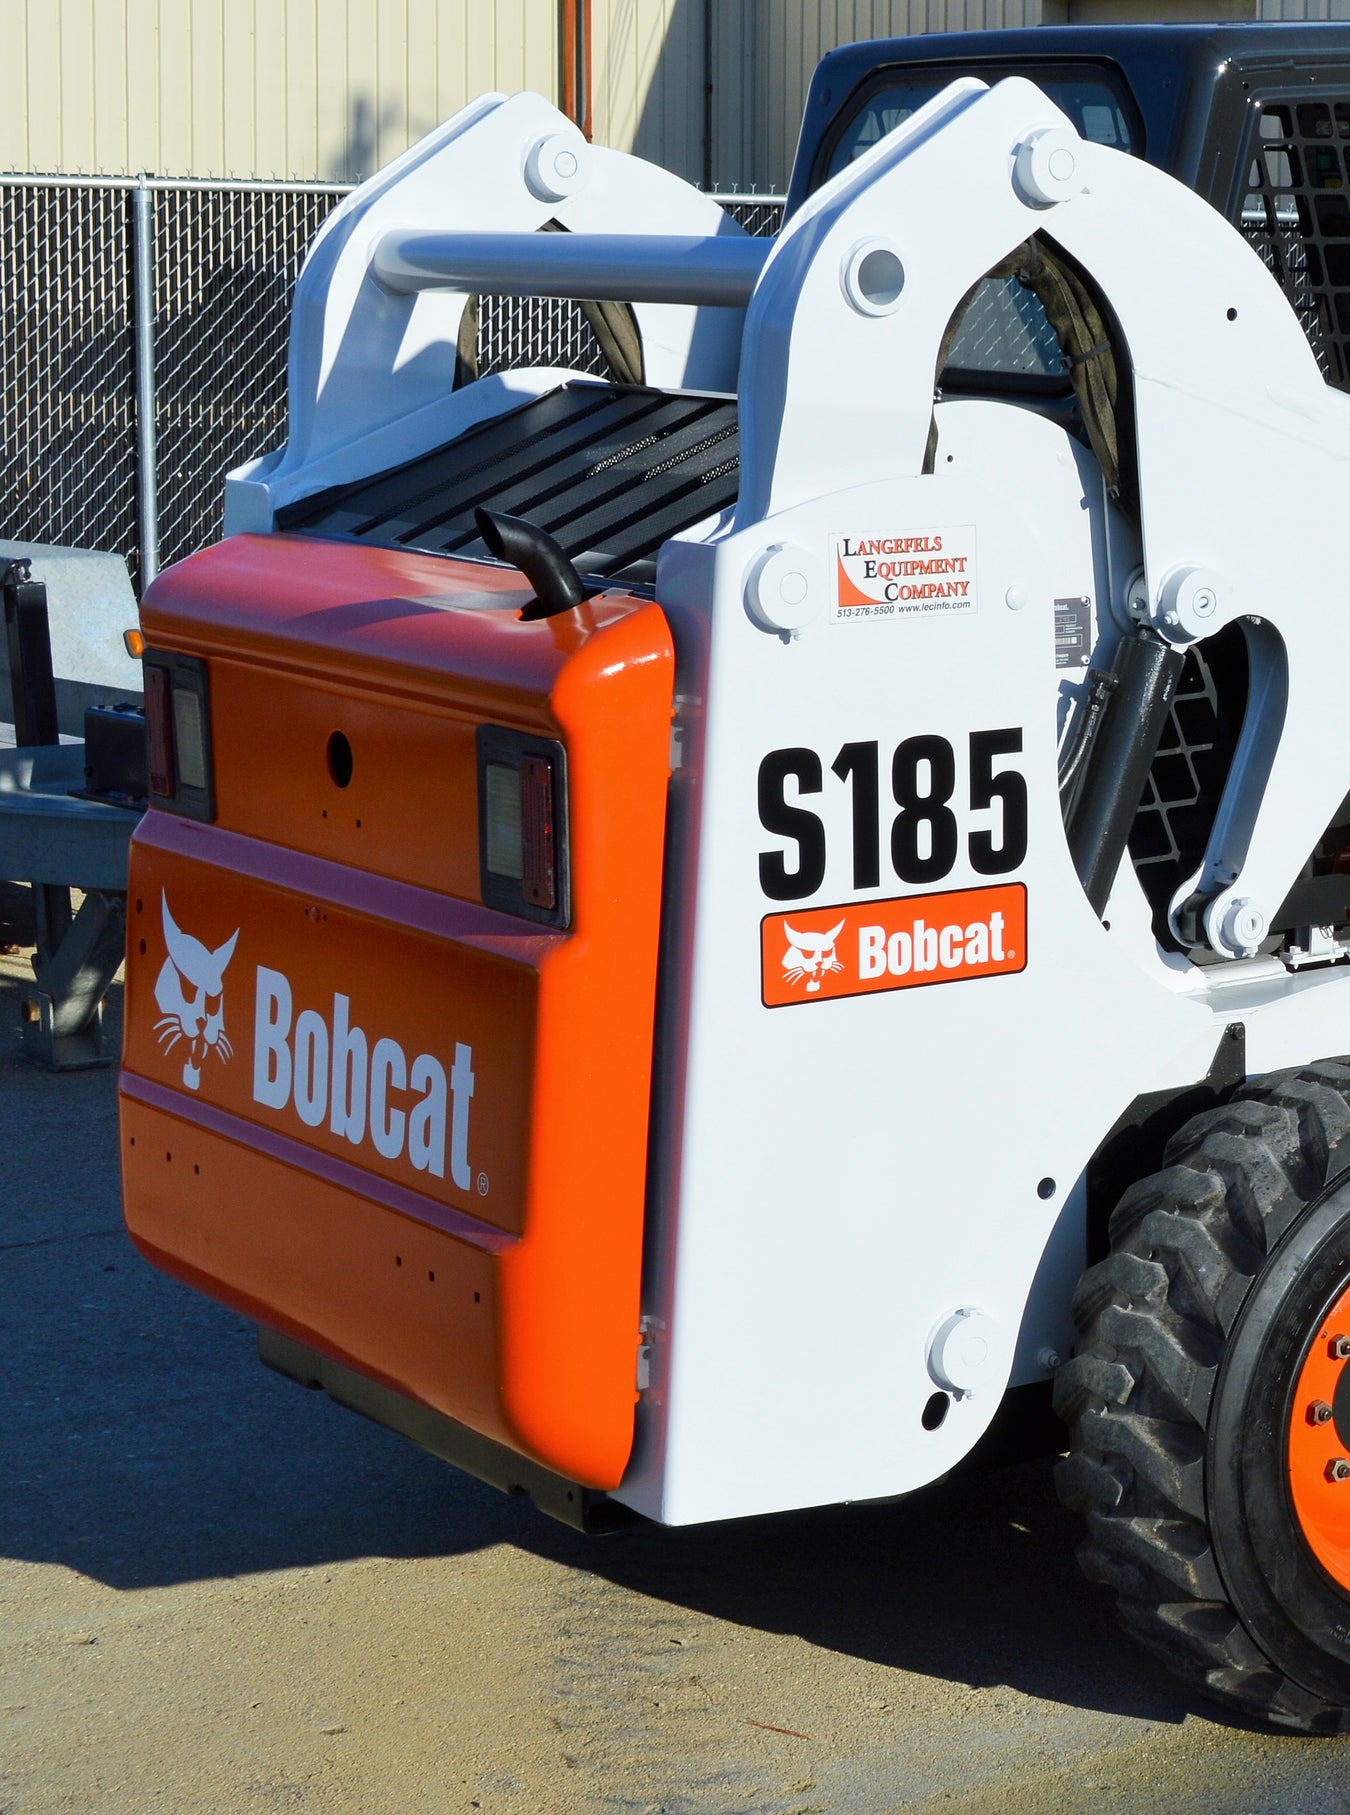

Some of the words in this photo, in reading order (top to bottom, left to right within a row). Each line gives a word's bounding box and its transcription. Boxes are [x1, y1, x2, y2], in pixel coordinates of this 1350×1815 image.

[843, 536, 943, 557] LANGEFELS
[864, 557, 967, 581] EQUIPMENT
[884, 581, 970, 601] COMPANY
[837, 605, 894, 618] 513-276-5500
[898, 600, 970, 613] www.lecinfo.com
[757, 726, 1028, 901] S185
[859, 912, 1004, 980] Bobcat
[253, 965, 474, 1191] Bobcat
